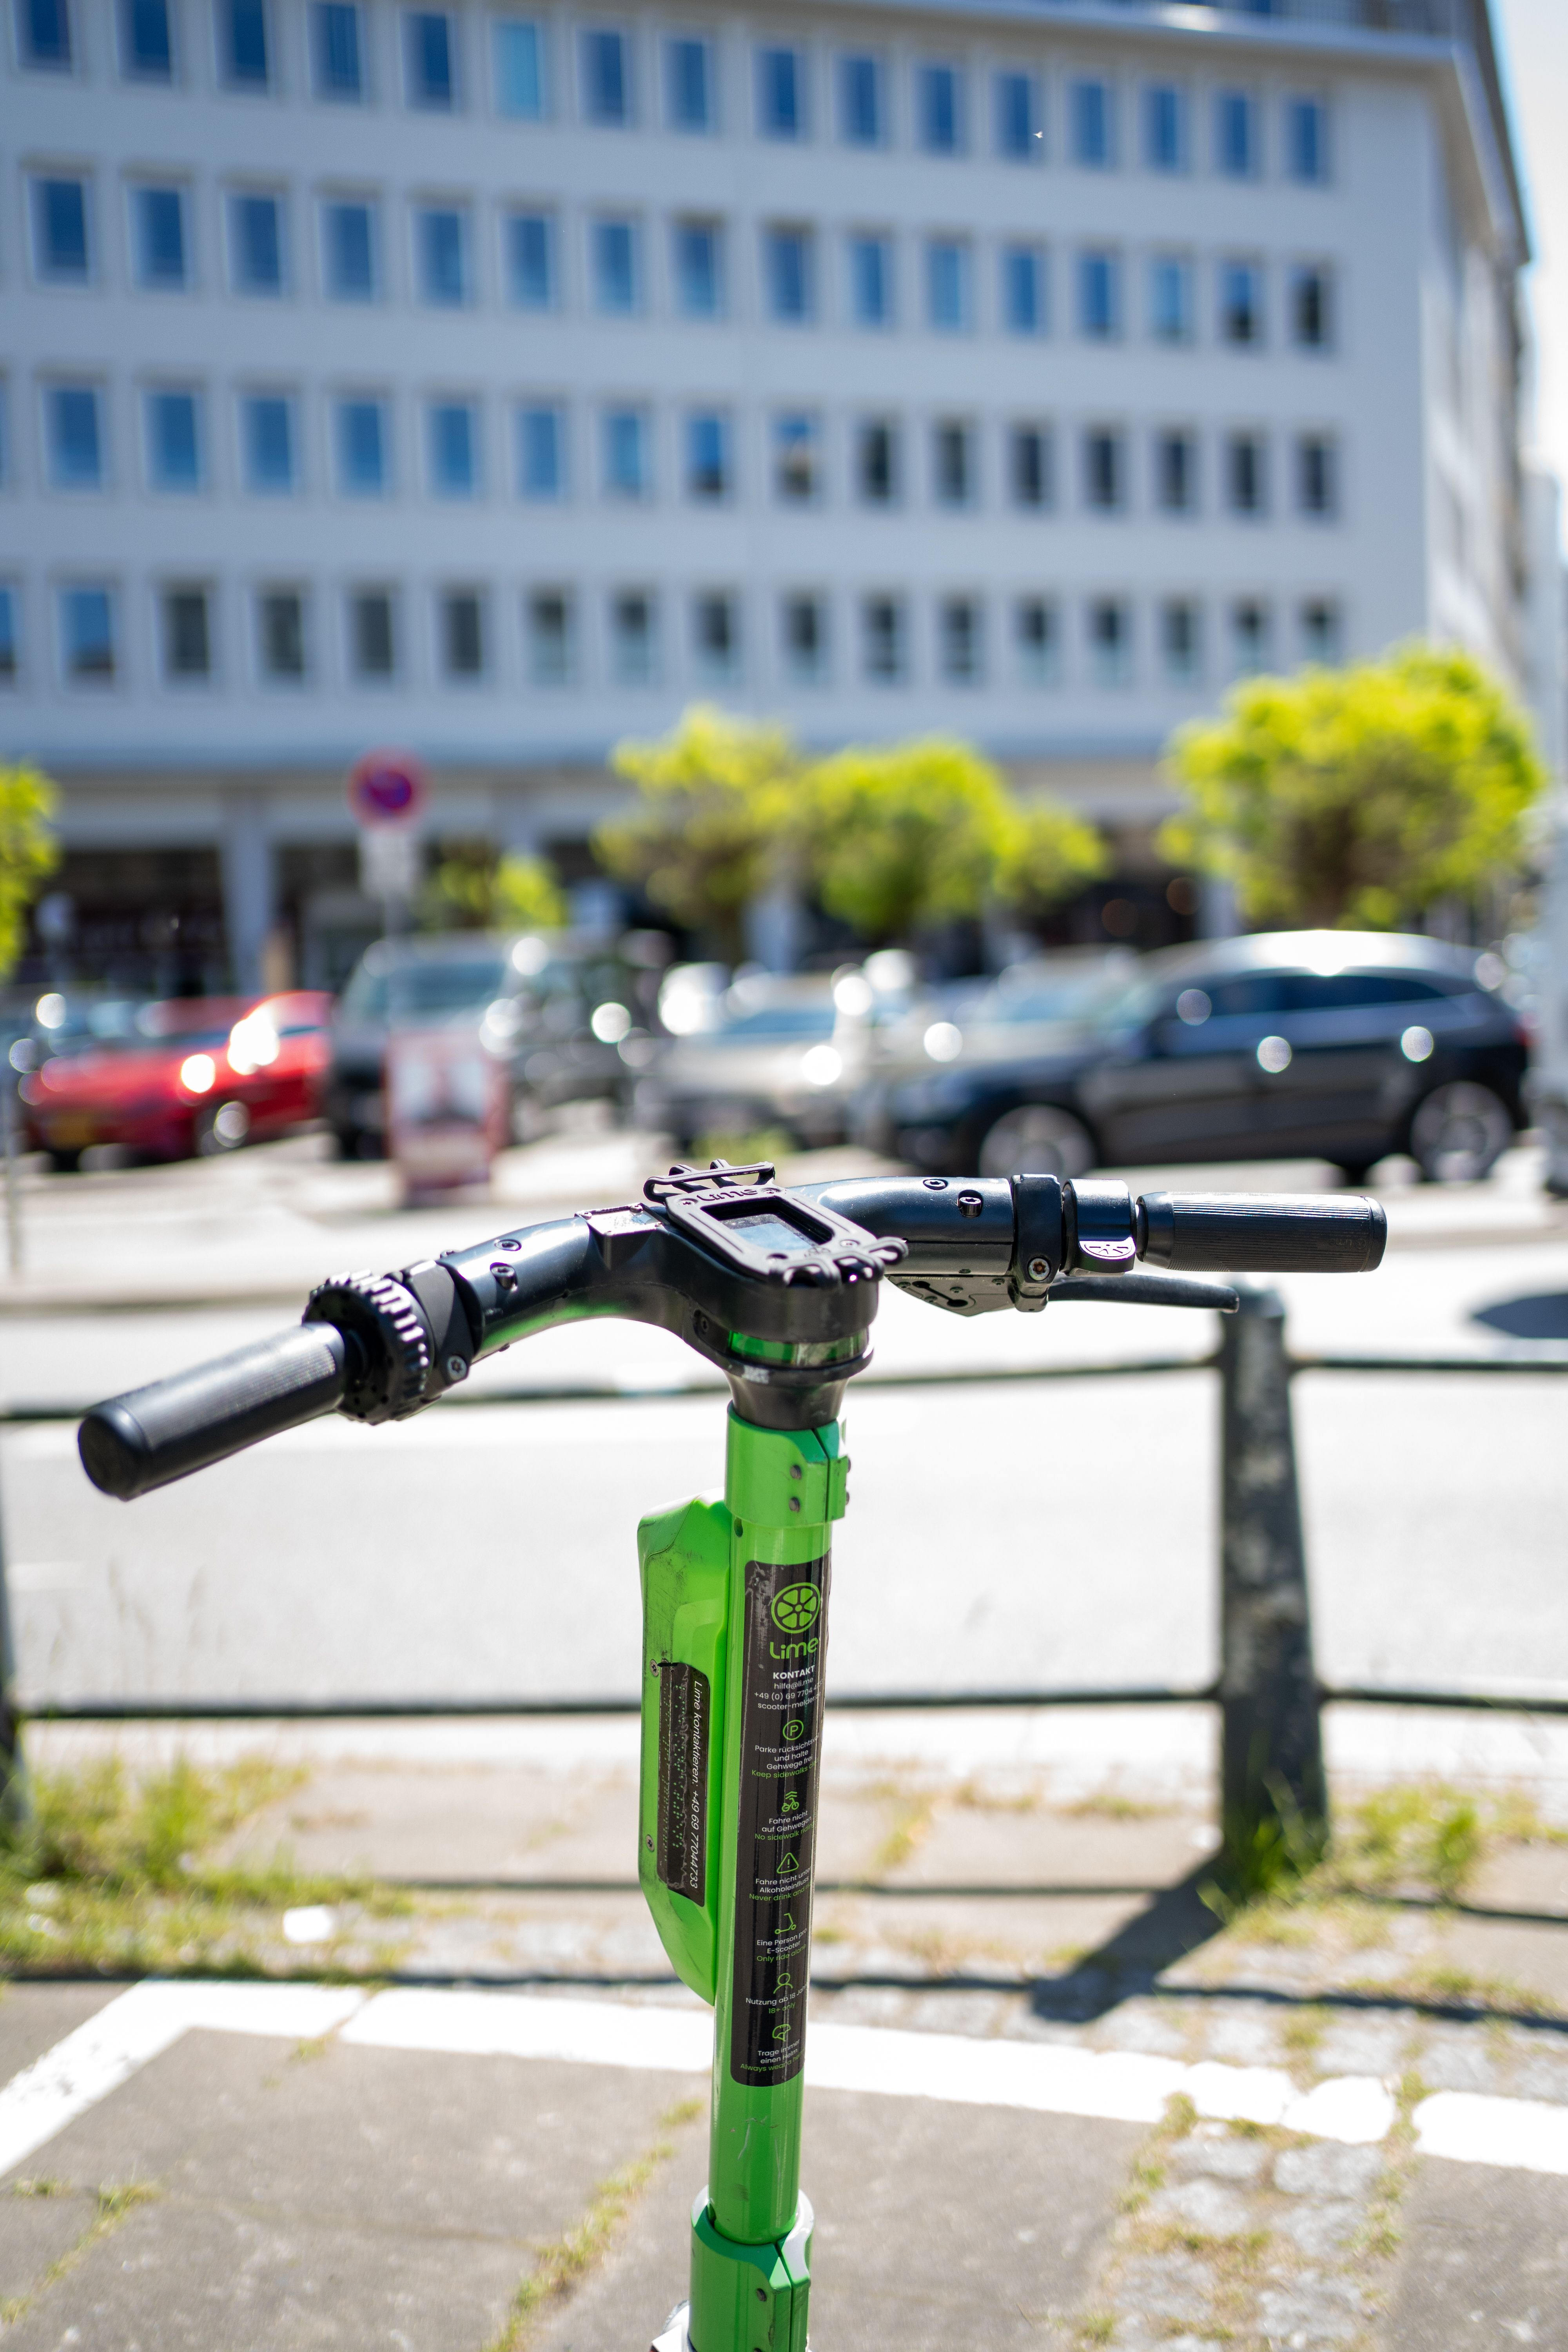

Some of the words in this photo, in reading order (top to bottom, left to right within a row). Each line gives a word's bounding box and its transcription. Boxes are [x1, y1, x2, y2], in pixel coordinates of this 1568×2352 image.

[697, 1189, 758, 1201] Lime
[769, 1637, 819, 1659] Lime
[773, 1665, 815, 1679] KONTAKT
[774, 1677, 813, 1690] hilfe@li.me
[693, 1681, 702, 1710] Lime
[771, 1692, 783, 1701] (0)
[797, 1688, 812, 1698] 7704
[691, 1712, 701, 1787] kontaktieren:
[755, 1745, 777, 1753] Parke
[792, 1750, 808, 1759] halte
[766, 1760, 802, 1770] Gehwege
[804, 1754, 813, 1766] frei
[752, 1769, 771, 1779] Keep
[773, 1766, 808, 1778] sidewalks
[691, 1814, 699, 1829] 69
[792, 1810, 808, 1822] nicht
[767, 1830, 799, 1840] sidewalk
[800, 1821, 815, 1834] riding
[777, 1816, 811, 1832] Gehwegen
[690, 1833, 699, 1889] 77044733
[780, 1875, 797, 1884] nicht
[797, 1867, 811, 1878] unter
[759, 1876, 809, 1893] Alkoholeinfluss
[773, 1892, 791, 1901] drink
[793, 1886, 804, 1896] and
[775, 1935, 798, 1945] Person
[799, 1928, 807, 1939] pro
[767, 1941, 801, 1954] E-Scooter
[791, 1944, 806, 1956] alone
[746, 1998, 777, 2006] Nutzung
[782, 2002, 796, 2011] only
[781, 2039, 800, 2053] immer
[782, 2049, 797, 2060] Helm
[740, 2063, 767, 2073] Always
[768, 2062, 785, 2071] wear
